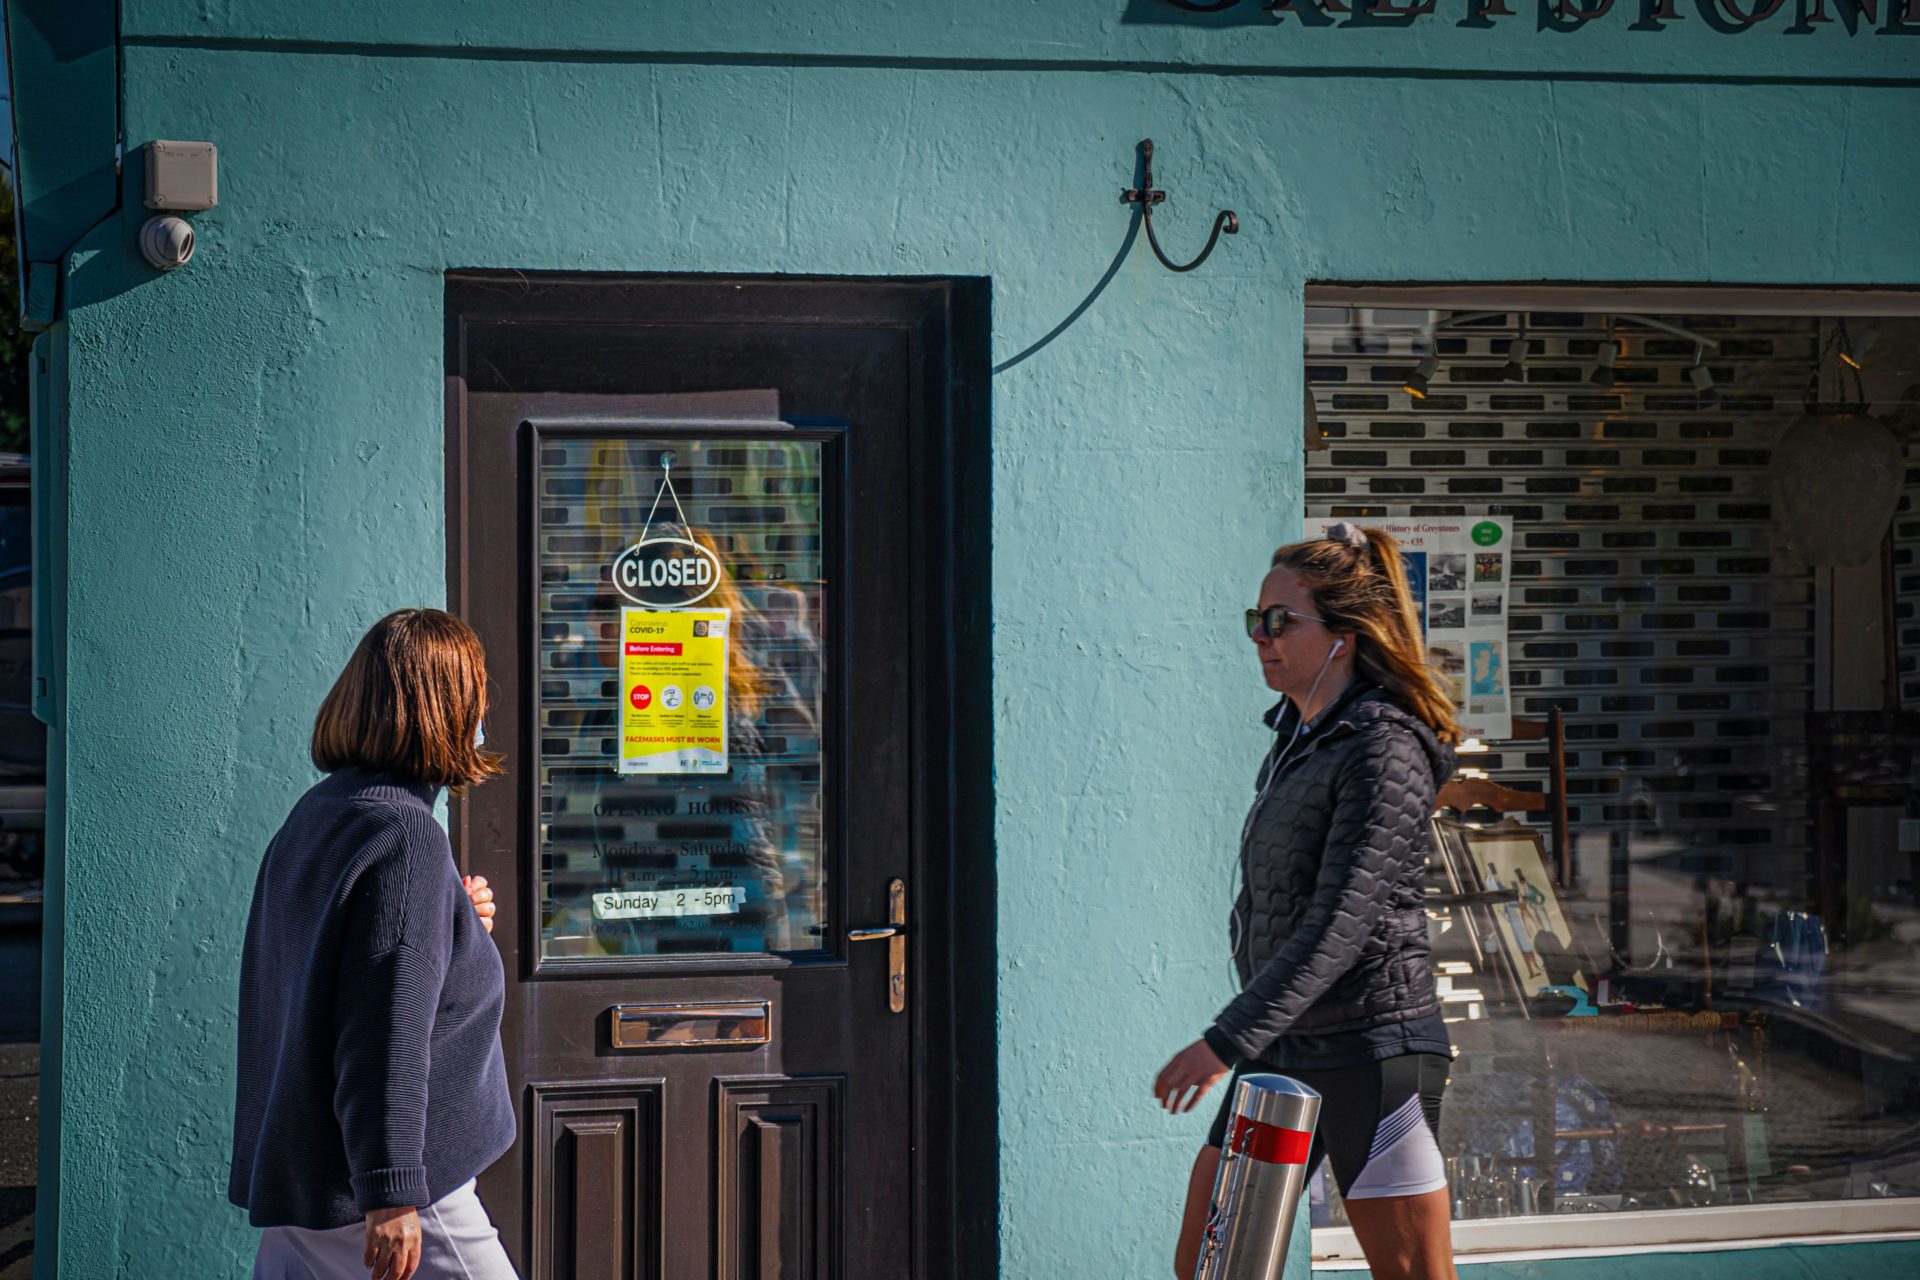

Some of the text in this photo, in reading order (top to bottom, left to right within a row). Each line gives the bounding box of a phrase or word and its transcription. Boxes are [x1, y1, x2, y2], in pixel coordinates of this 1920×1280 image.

[1386, 524, 1411, 534] History
[1413, 524, 1420, 532] of
[1422, 524, 1460, 534] Greystones
[622, 558, 711, 587] CLOSED
[650, 645, 675, 653] Entering
[593, 801, 750, 817] OPENING HOURS
[592, 842, 656, 858] Monday
[680, 840, 748, 857] Saturday
[690, 866, 699, 879] 5
[604, 895, 658, 911] Sunday
[676, 893, 685, 906] 2
[704, 892, 735, 907] 5pm
